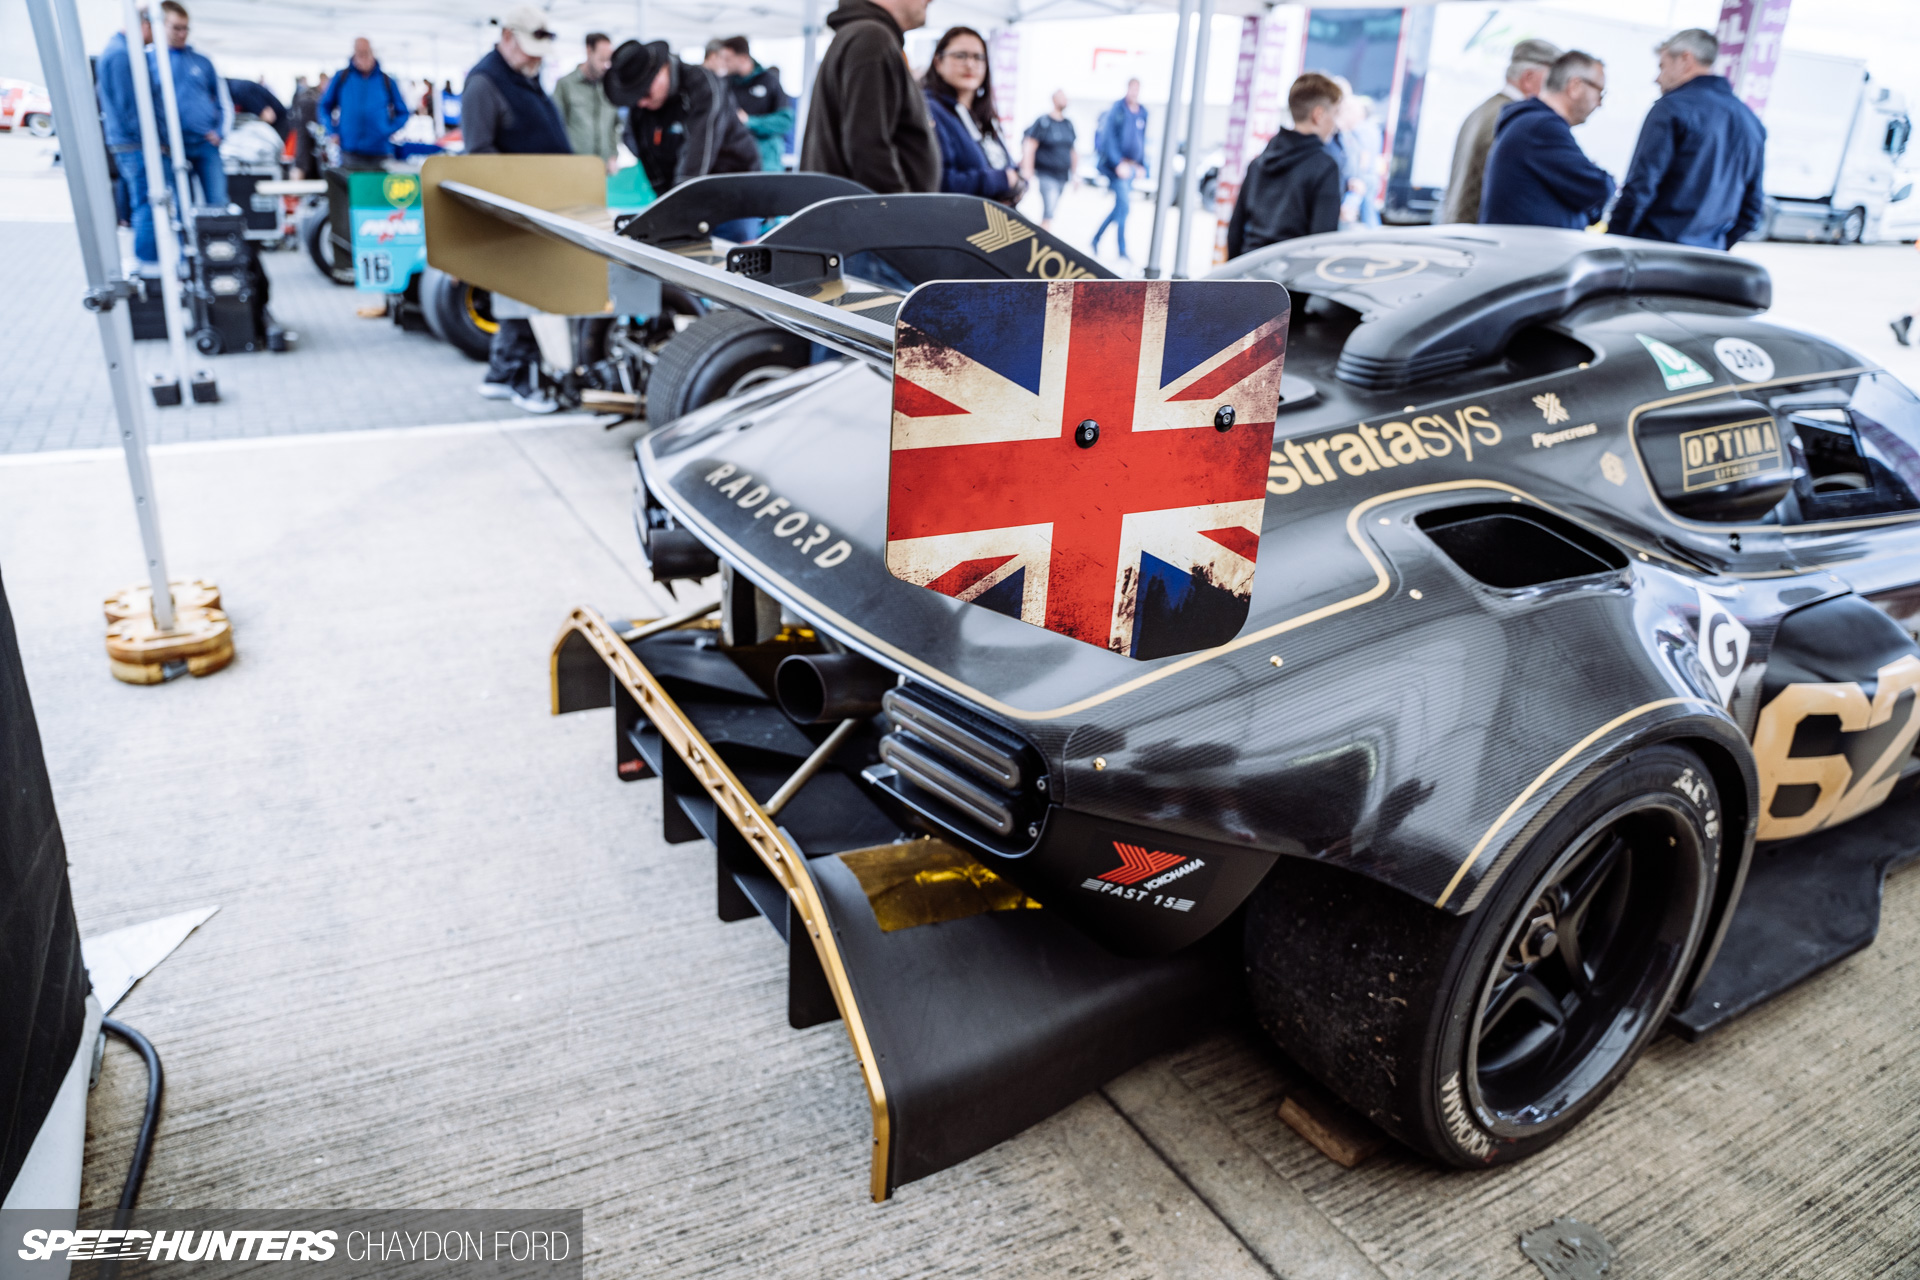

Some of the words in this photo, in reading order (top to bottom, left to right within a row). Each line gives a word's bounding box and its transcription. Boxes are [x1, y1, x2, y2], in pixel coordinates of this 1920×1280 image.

[363, 256, 390, 284] 16
[1266, 405, 1503, 495] stratasys
[1687, 424, 1776, 467] OPTIMA
[705, 463, 852, 568] RADFORD
[1708, 612, 1739, 678] G
[1752, 654, 1920, 842] 62
[1101, 882, 1149, 902] FAST
[1154, 895, 1176, 909] 15
[1143, 858, 1206, 891] YOKOHAMA
[1441, 1071, 1490, 1158] YOKOHAMA
